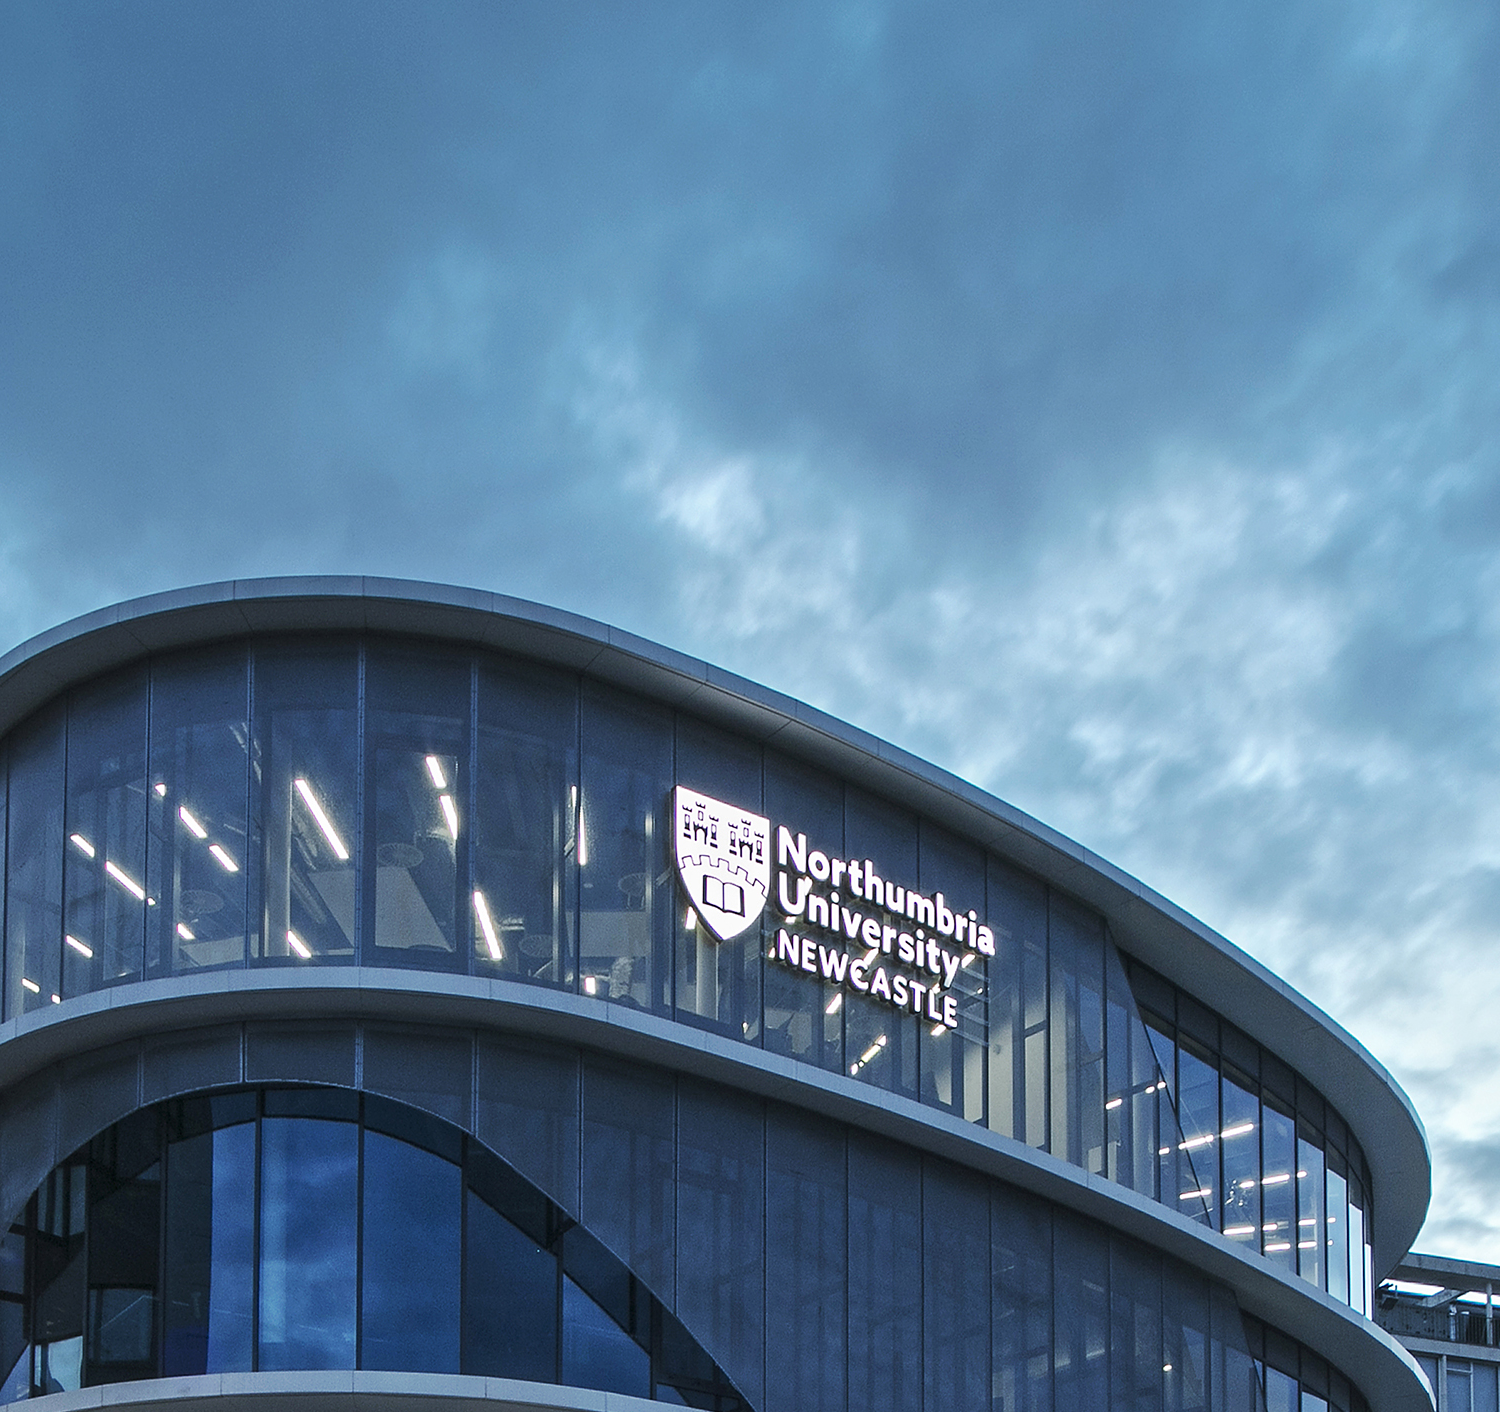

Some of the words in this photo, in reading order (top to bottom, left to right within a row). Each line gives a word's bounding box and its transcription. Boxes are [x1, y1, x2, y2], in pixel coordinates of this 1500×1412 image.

[777, 825, 995, 956] Northumbria
[777, 871, 960, 988] University
[776, 928, 958, 1028] NEWCASTLE
